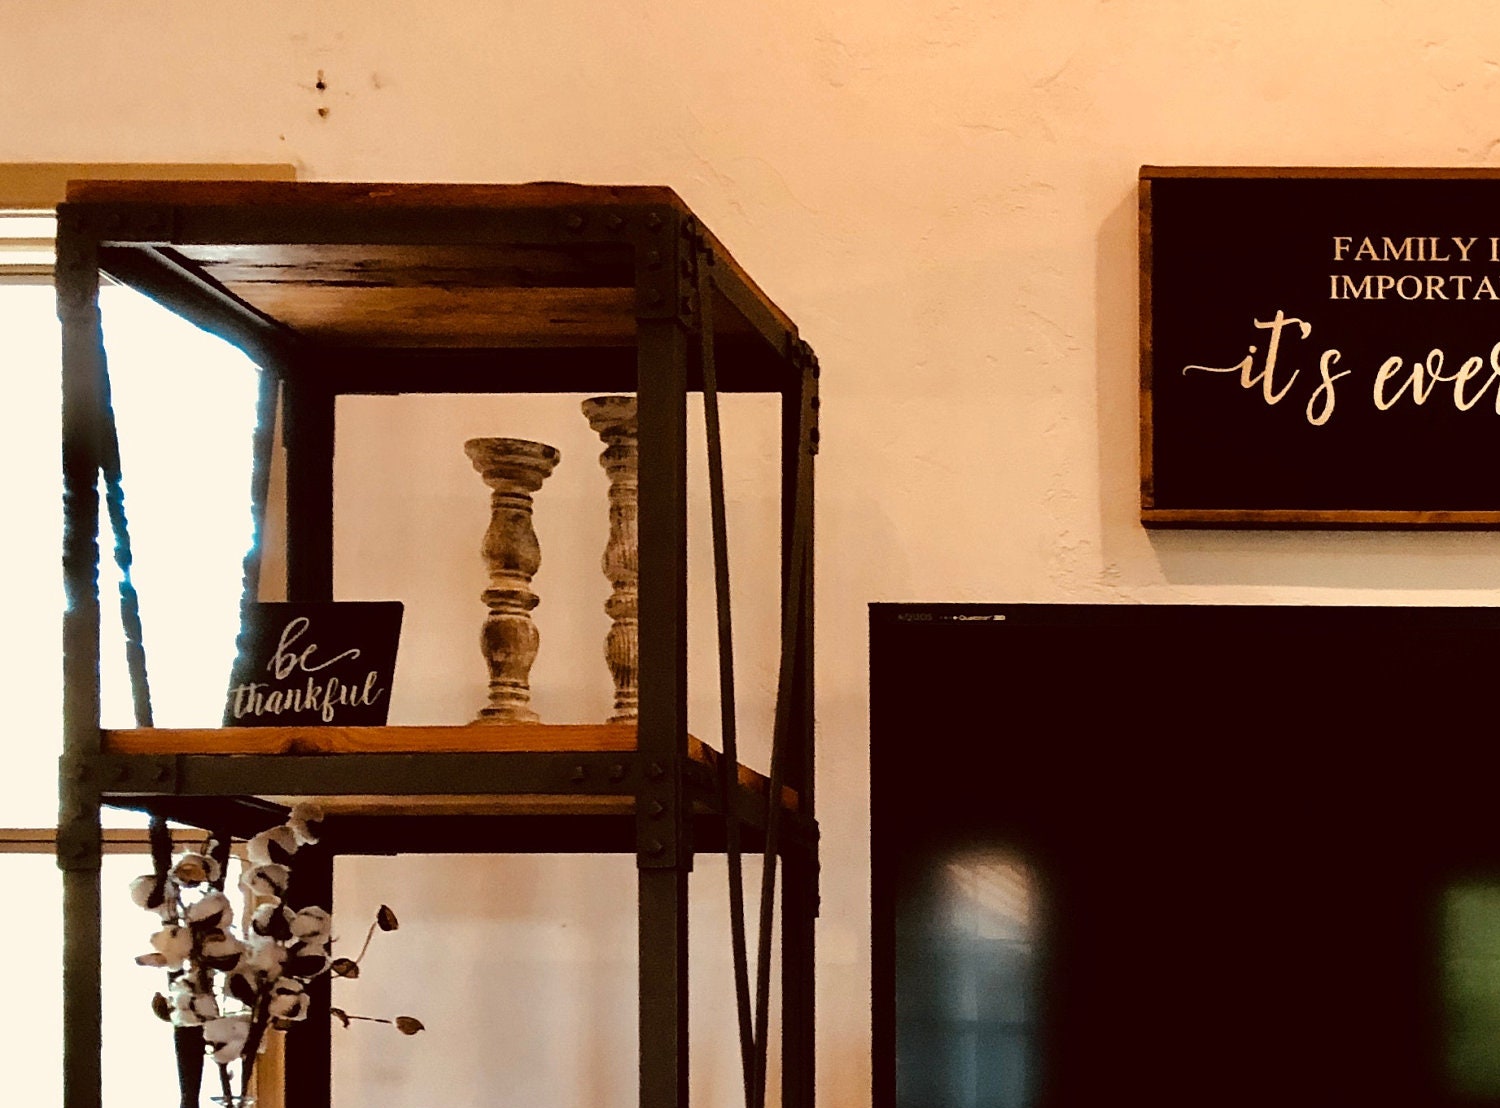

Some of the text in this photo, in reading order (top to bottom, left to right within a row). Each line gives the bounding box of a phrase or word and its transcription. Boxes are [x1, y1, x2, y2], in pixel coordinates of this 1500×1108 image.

[1333, 236, 1478, 262] FAMILY
[1183, 309, 1352, 427] it's
[267, 616, 361, 681] be
[230, 670, 385, 723] thankful
